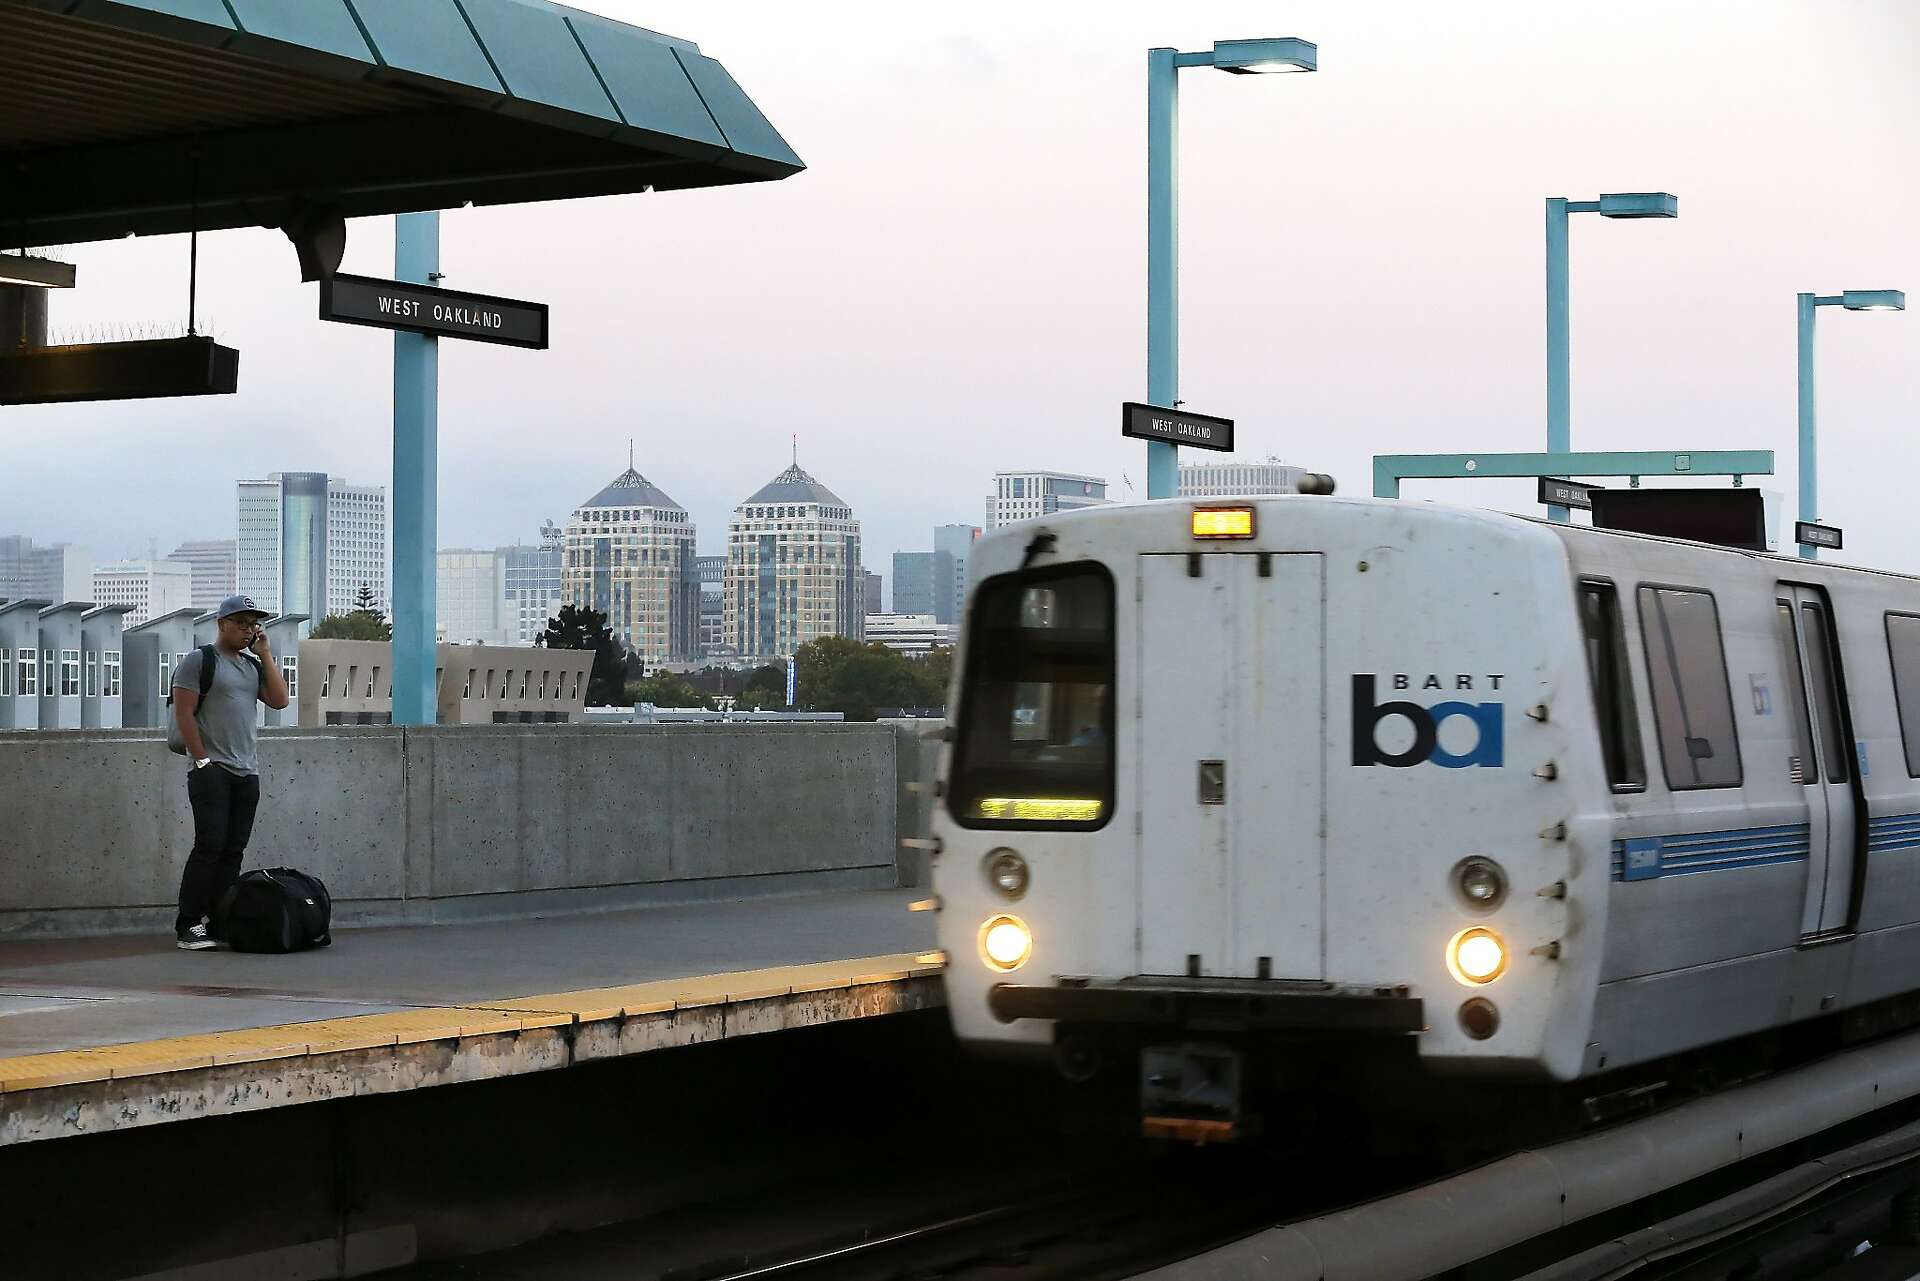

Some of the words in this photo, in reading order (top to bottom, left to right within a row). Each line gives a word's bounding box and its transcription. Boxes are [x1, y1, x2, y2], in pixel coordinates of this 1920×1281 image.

[378, 296, 420, 318] WEST
[433, 304, 501, 329] OAKLAND
[1152, 418, 1172, 433] WEST
[1177, 423, 1211, 439] OAKLAND
[1556, 488, 1569, 499] WEST
[1393, 674, 1504, 690] BART
